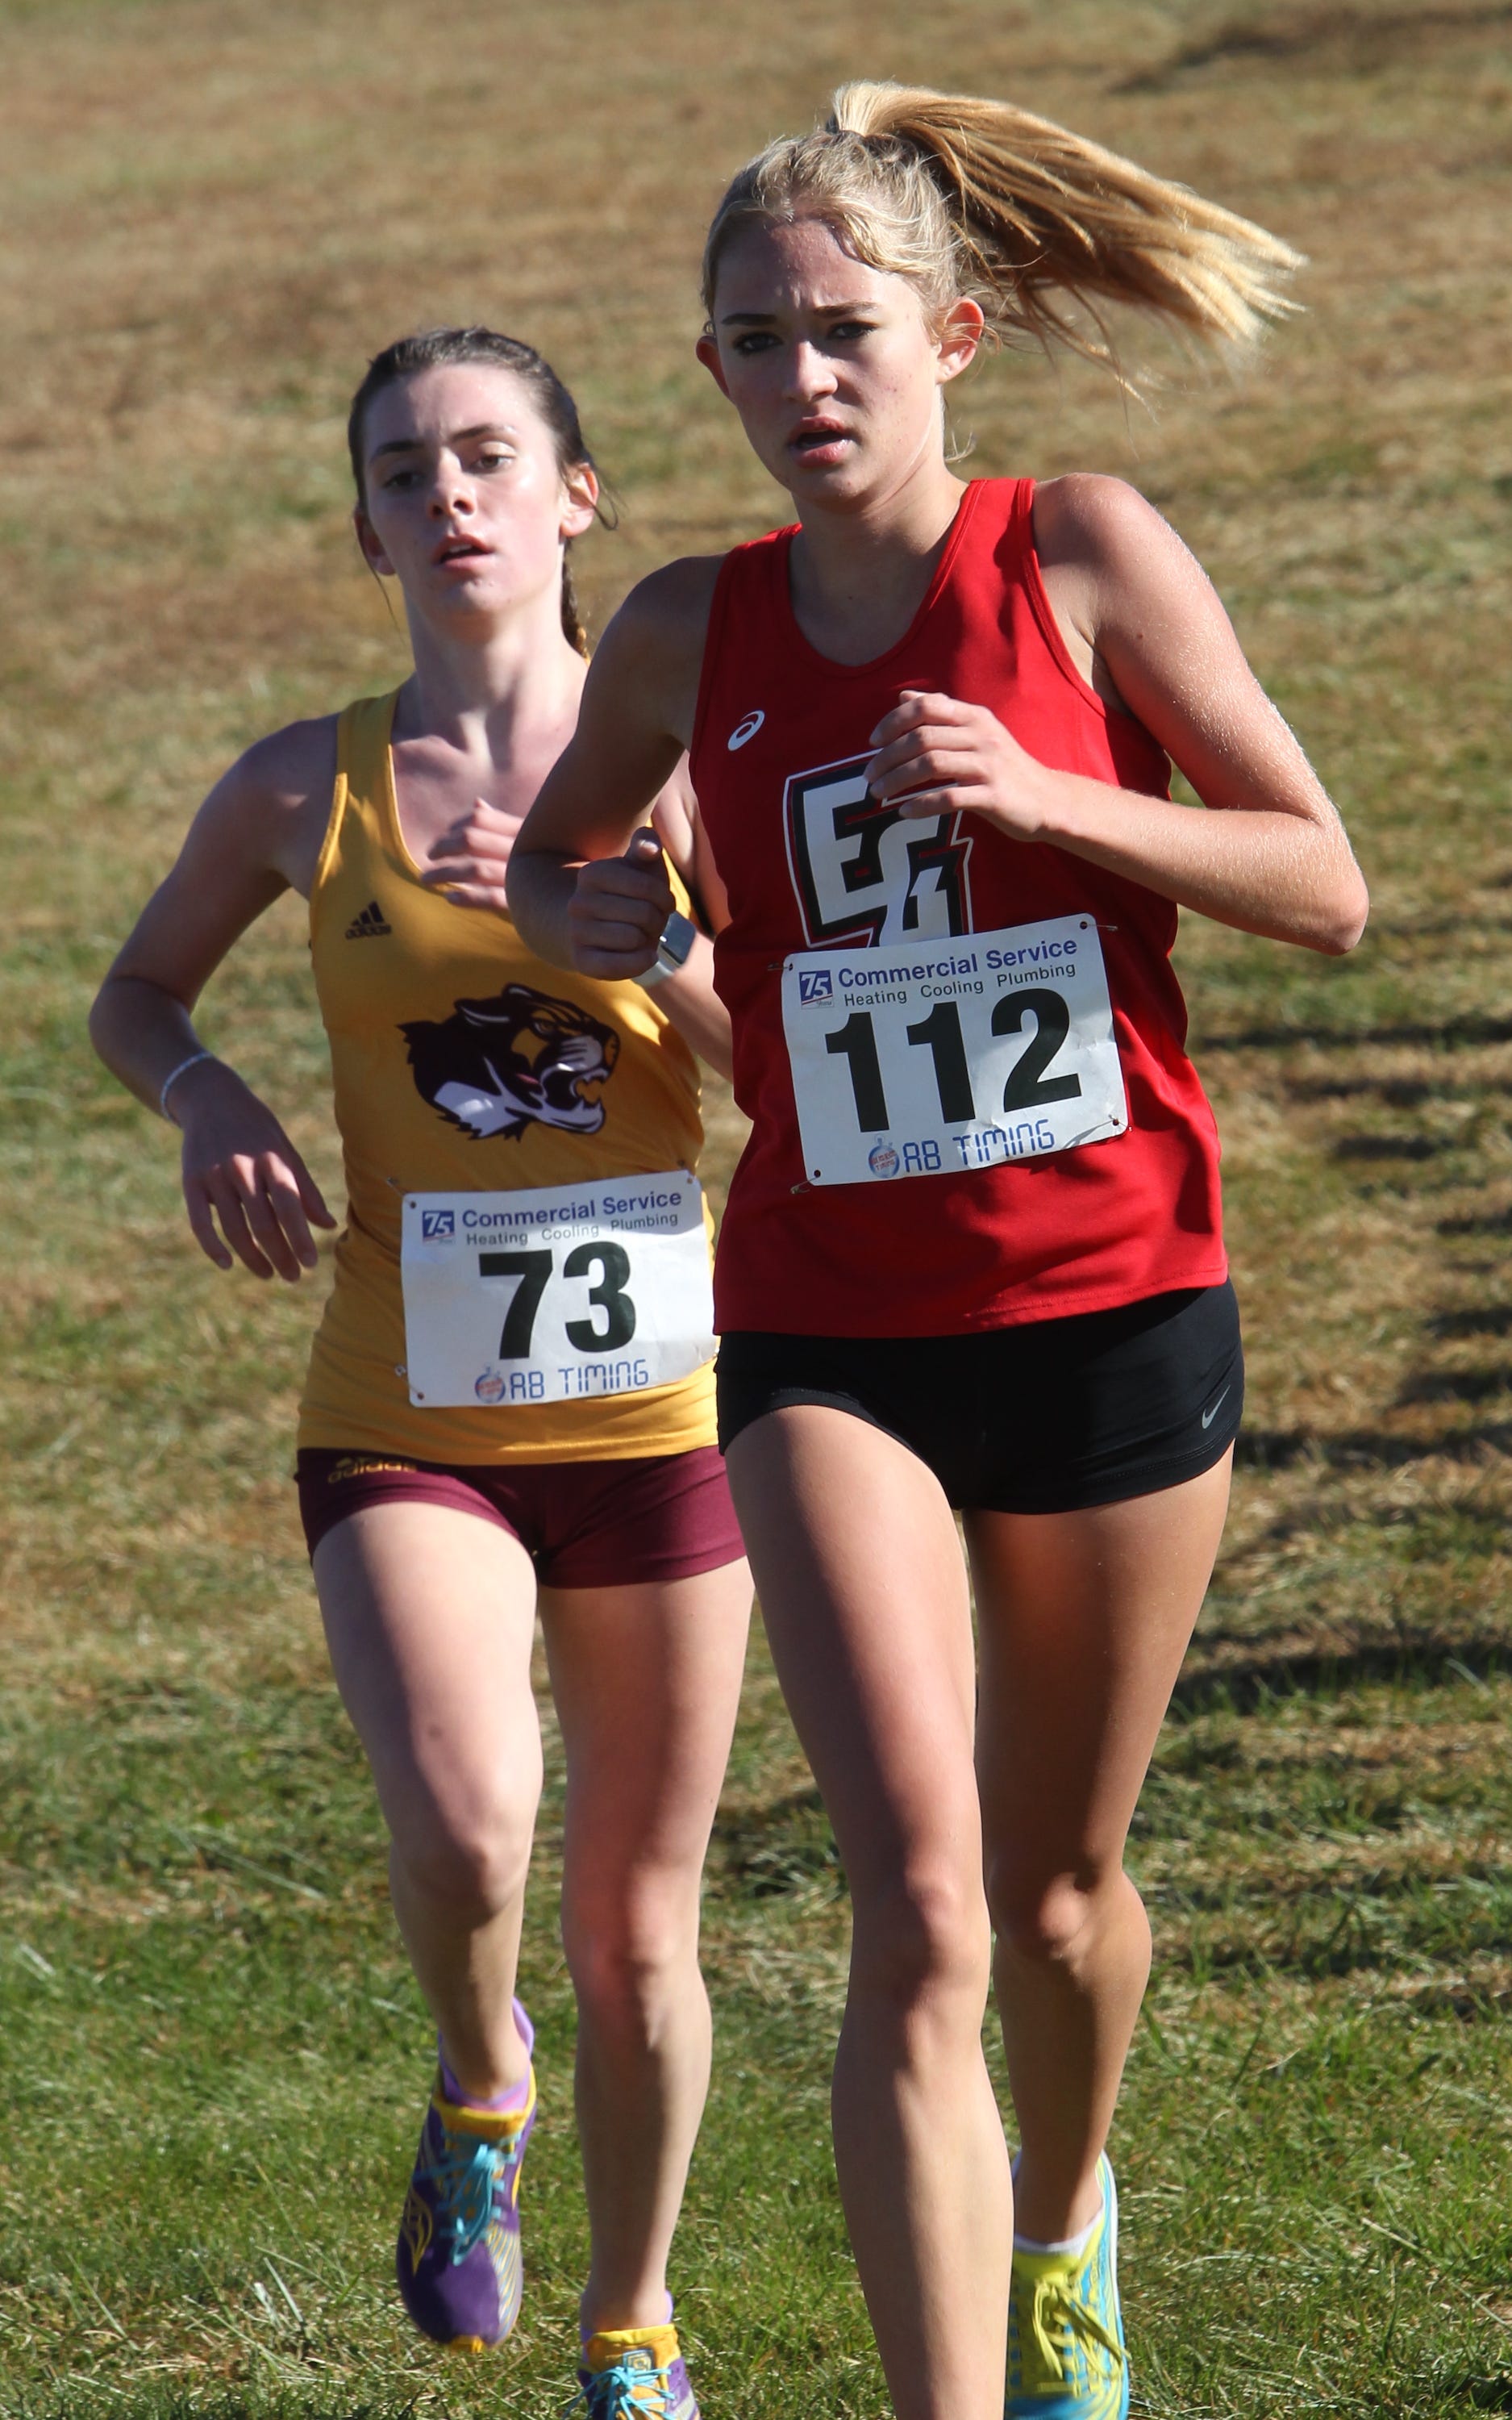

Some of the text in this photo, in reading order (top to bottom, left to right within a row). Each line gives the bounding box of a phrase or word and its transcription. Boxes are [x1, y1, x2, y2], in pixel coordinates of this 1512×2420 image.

[838, 937, 1078, 988] Commercial Service
[801, 973, 829, 999] 75
[843, 962, 1077, 1008] Heating Cooling Plumbing
[824, 987, 1083, 1133] 112
[952, 1118, 1056, 1166] TIMING
[424, 1212, 452, 1237] 75
[462, 1190, 682, 1229] Commercial Service
[466, 1212, 679, 1246] Heating Cooling Plumbing
[478, 1241, 637, 1360] 73
[558, 1358, 650, 1396] TIMING
